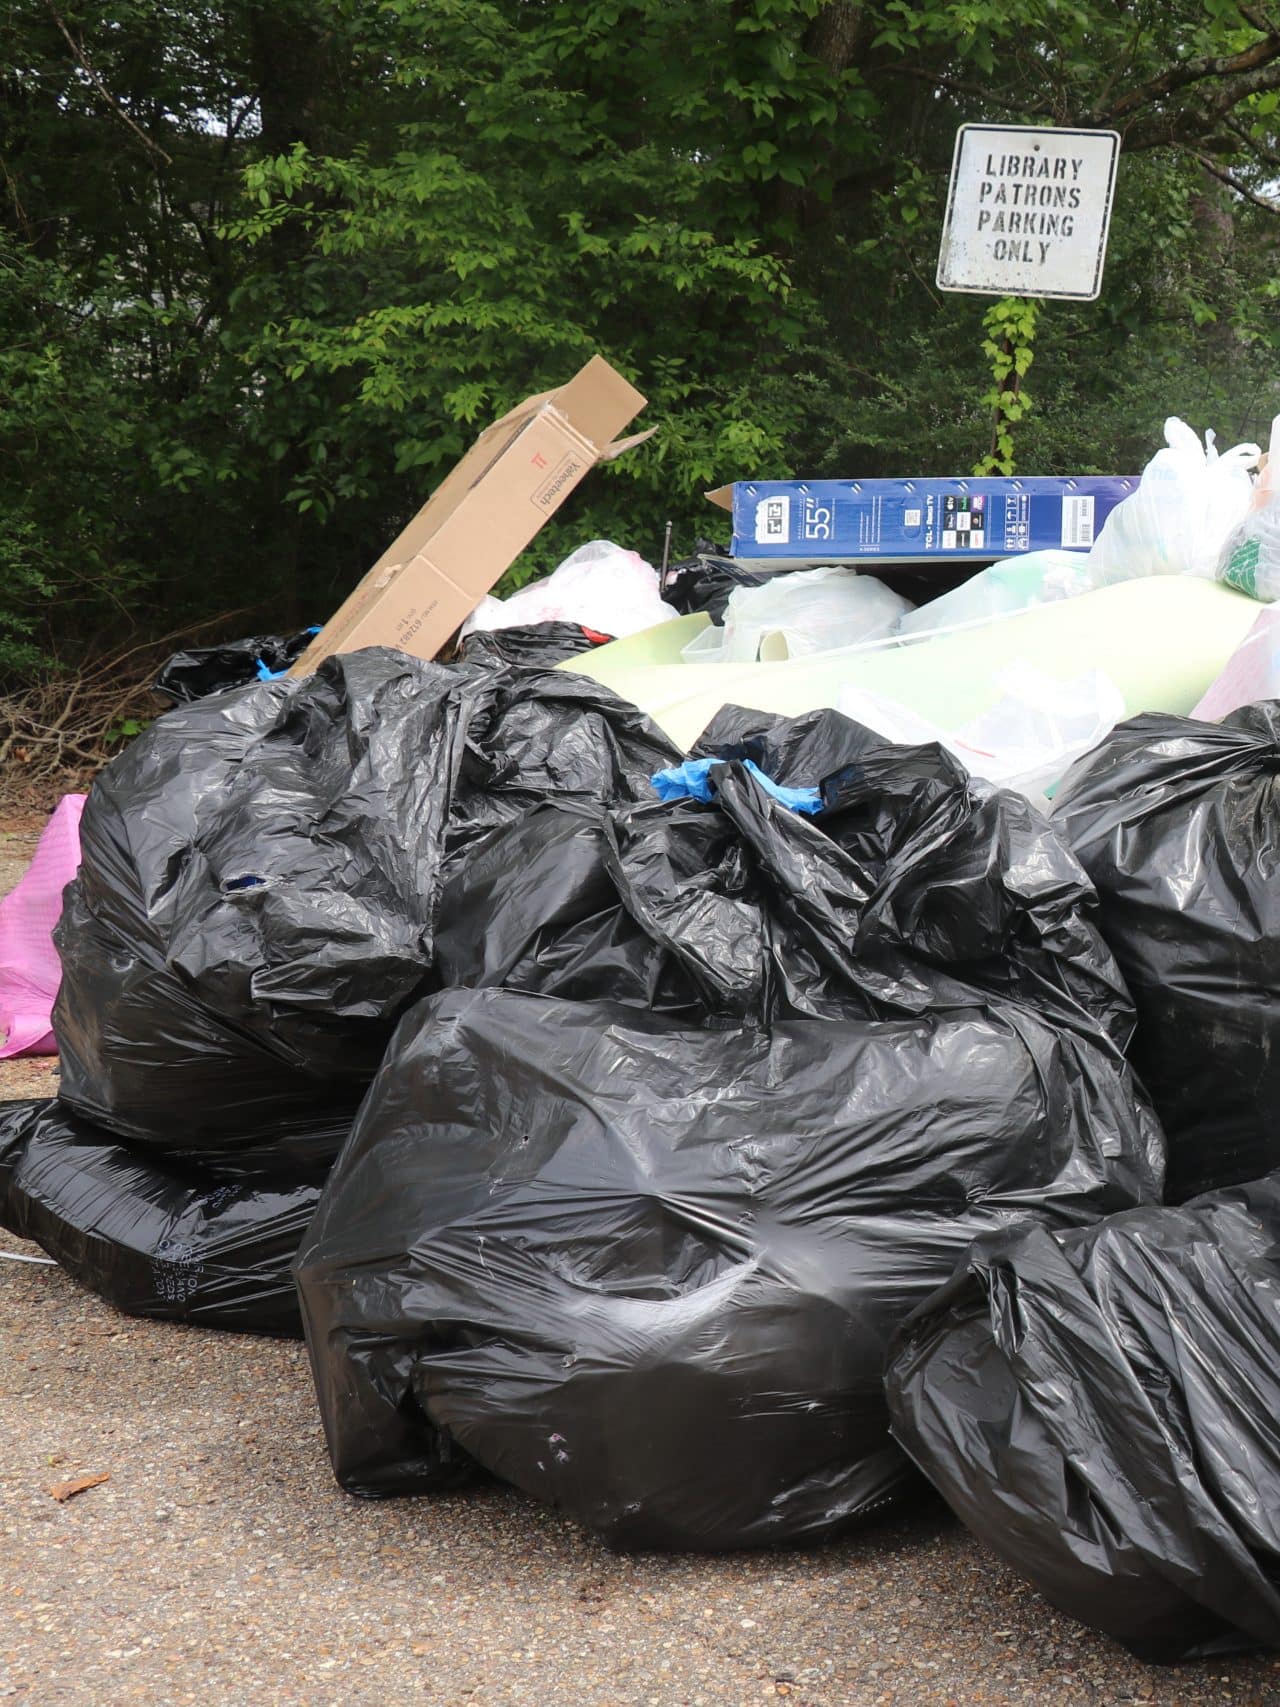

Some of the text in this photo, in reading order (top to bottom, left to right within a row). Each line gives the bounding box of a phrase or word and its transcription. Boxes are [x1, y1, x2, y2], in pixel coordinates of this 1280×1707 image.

[985, 154, 1083, 180] LIBRARY
[979, 182, 1082, 209] PATRONS
[977, 210, 1074, 237] PARKING
[992, 239, 1051, 266] ONLY
[926, 494, 934, 505] TV
[925, 530, 933, 549] TCL
